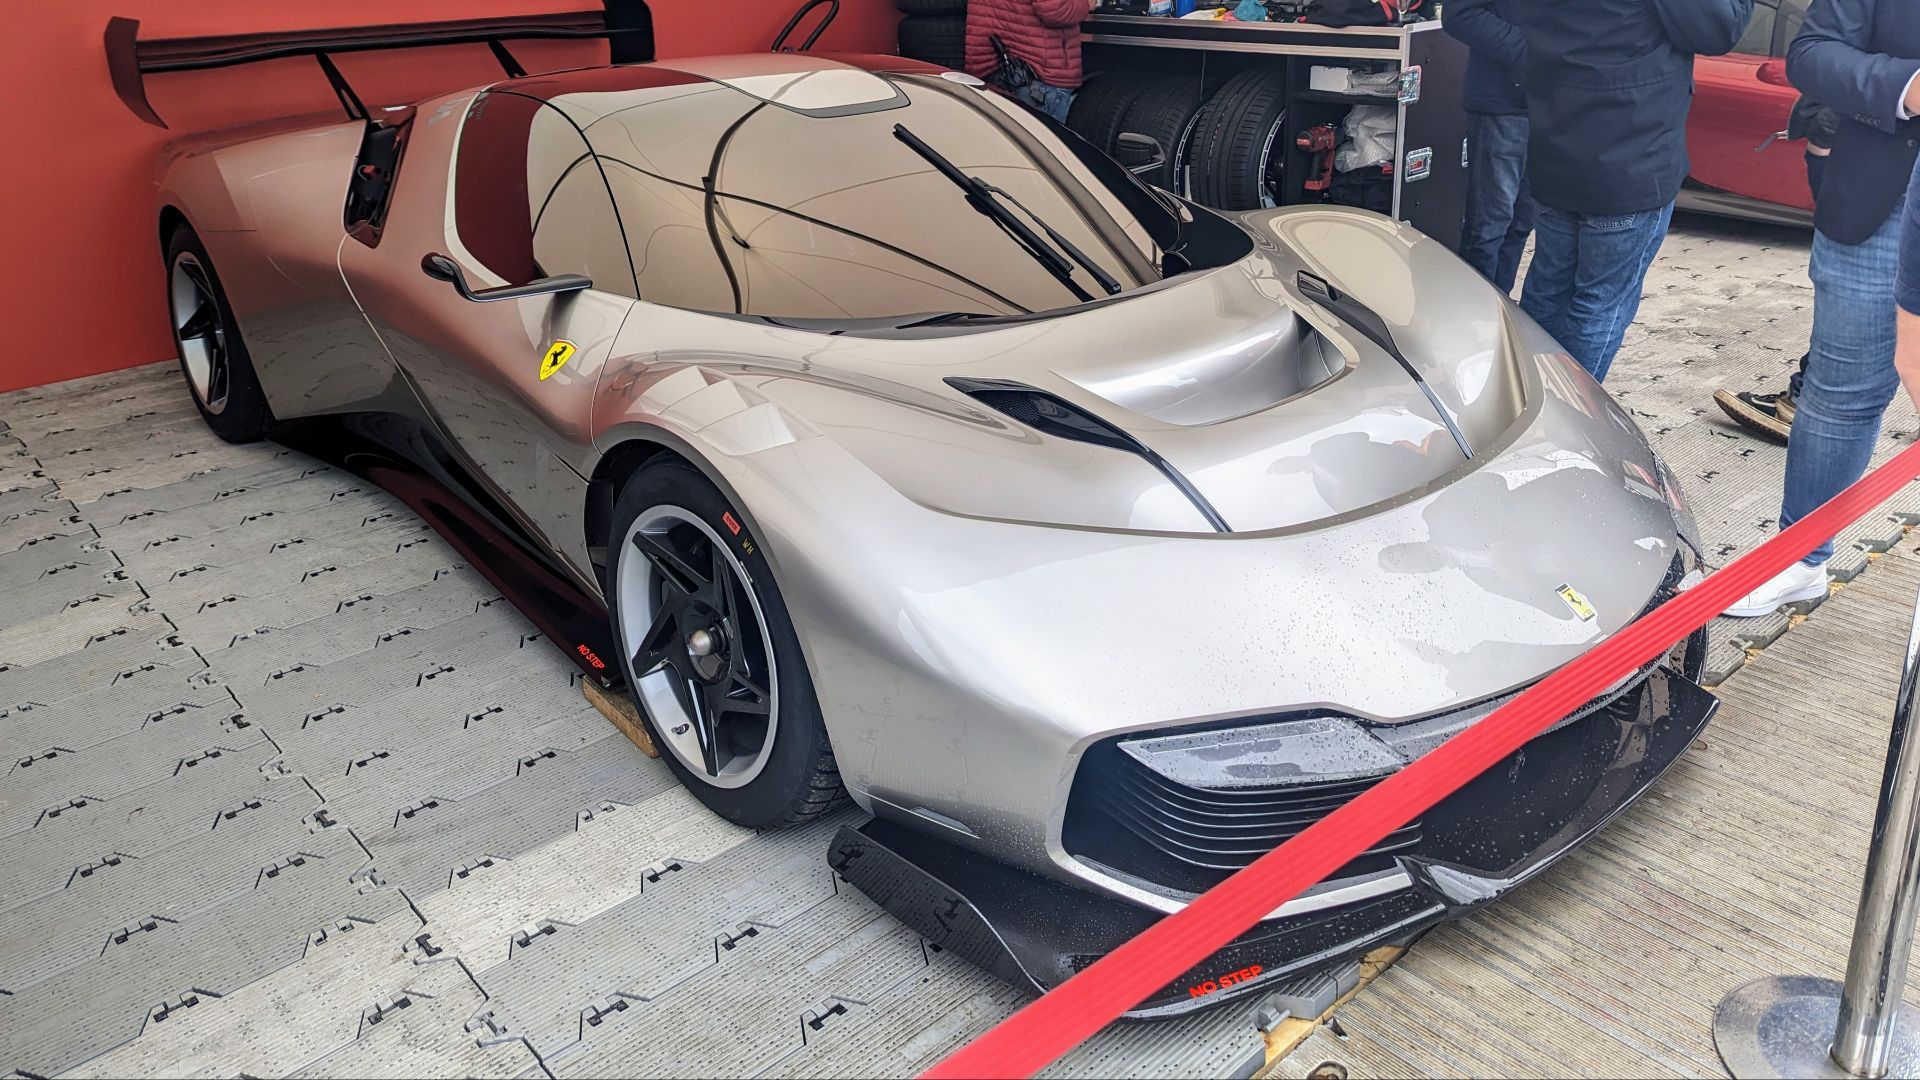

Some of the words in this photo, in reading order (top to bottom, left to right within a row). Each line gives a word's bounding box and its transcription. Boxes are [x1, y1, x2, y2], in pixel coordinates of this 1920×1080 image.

[577, 644, 590, 655] NO
[586, 653, 605, 669] STEP
[1188, 980, 1217, 999] NO
[1218, 964, 1263, 989] STEP
